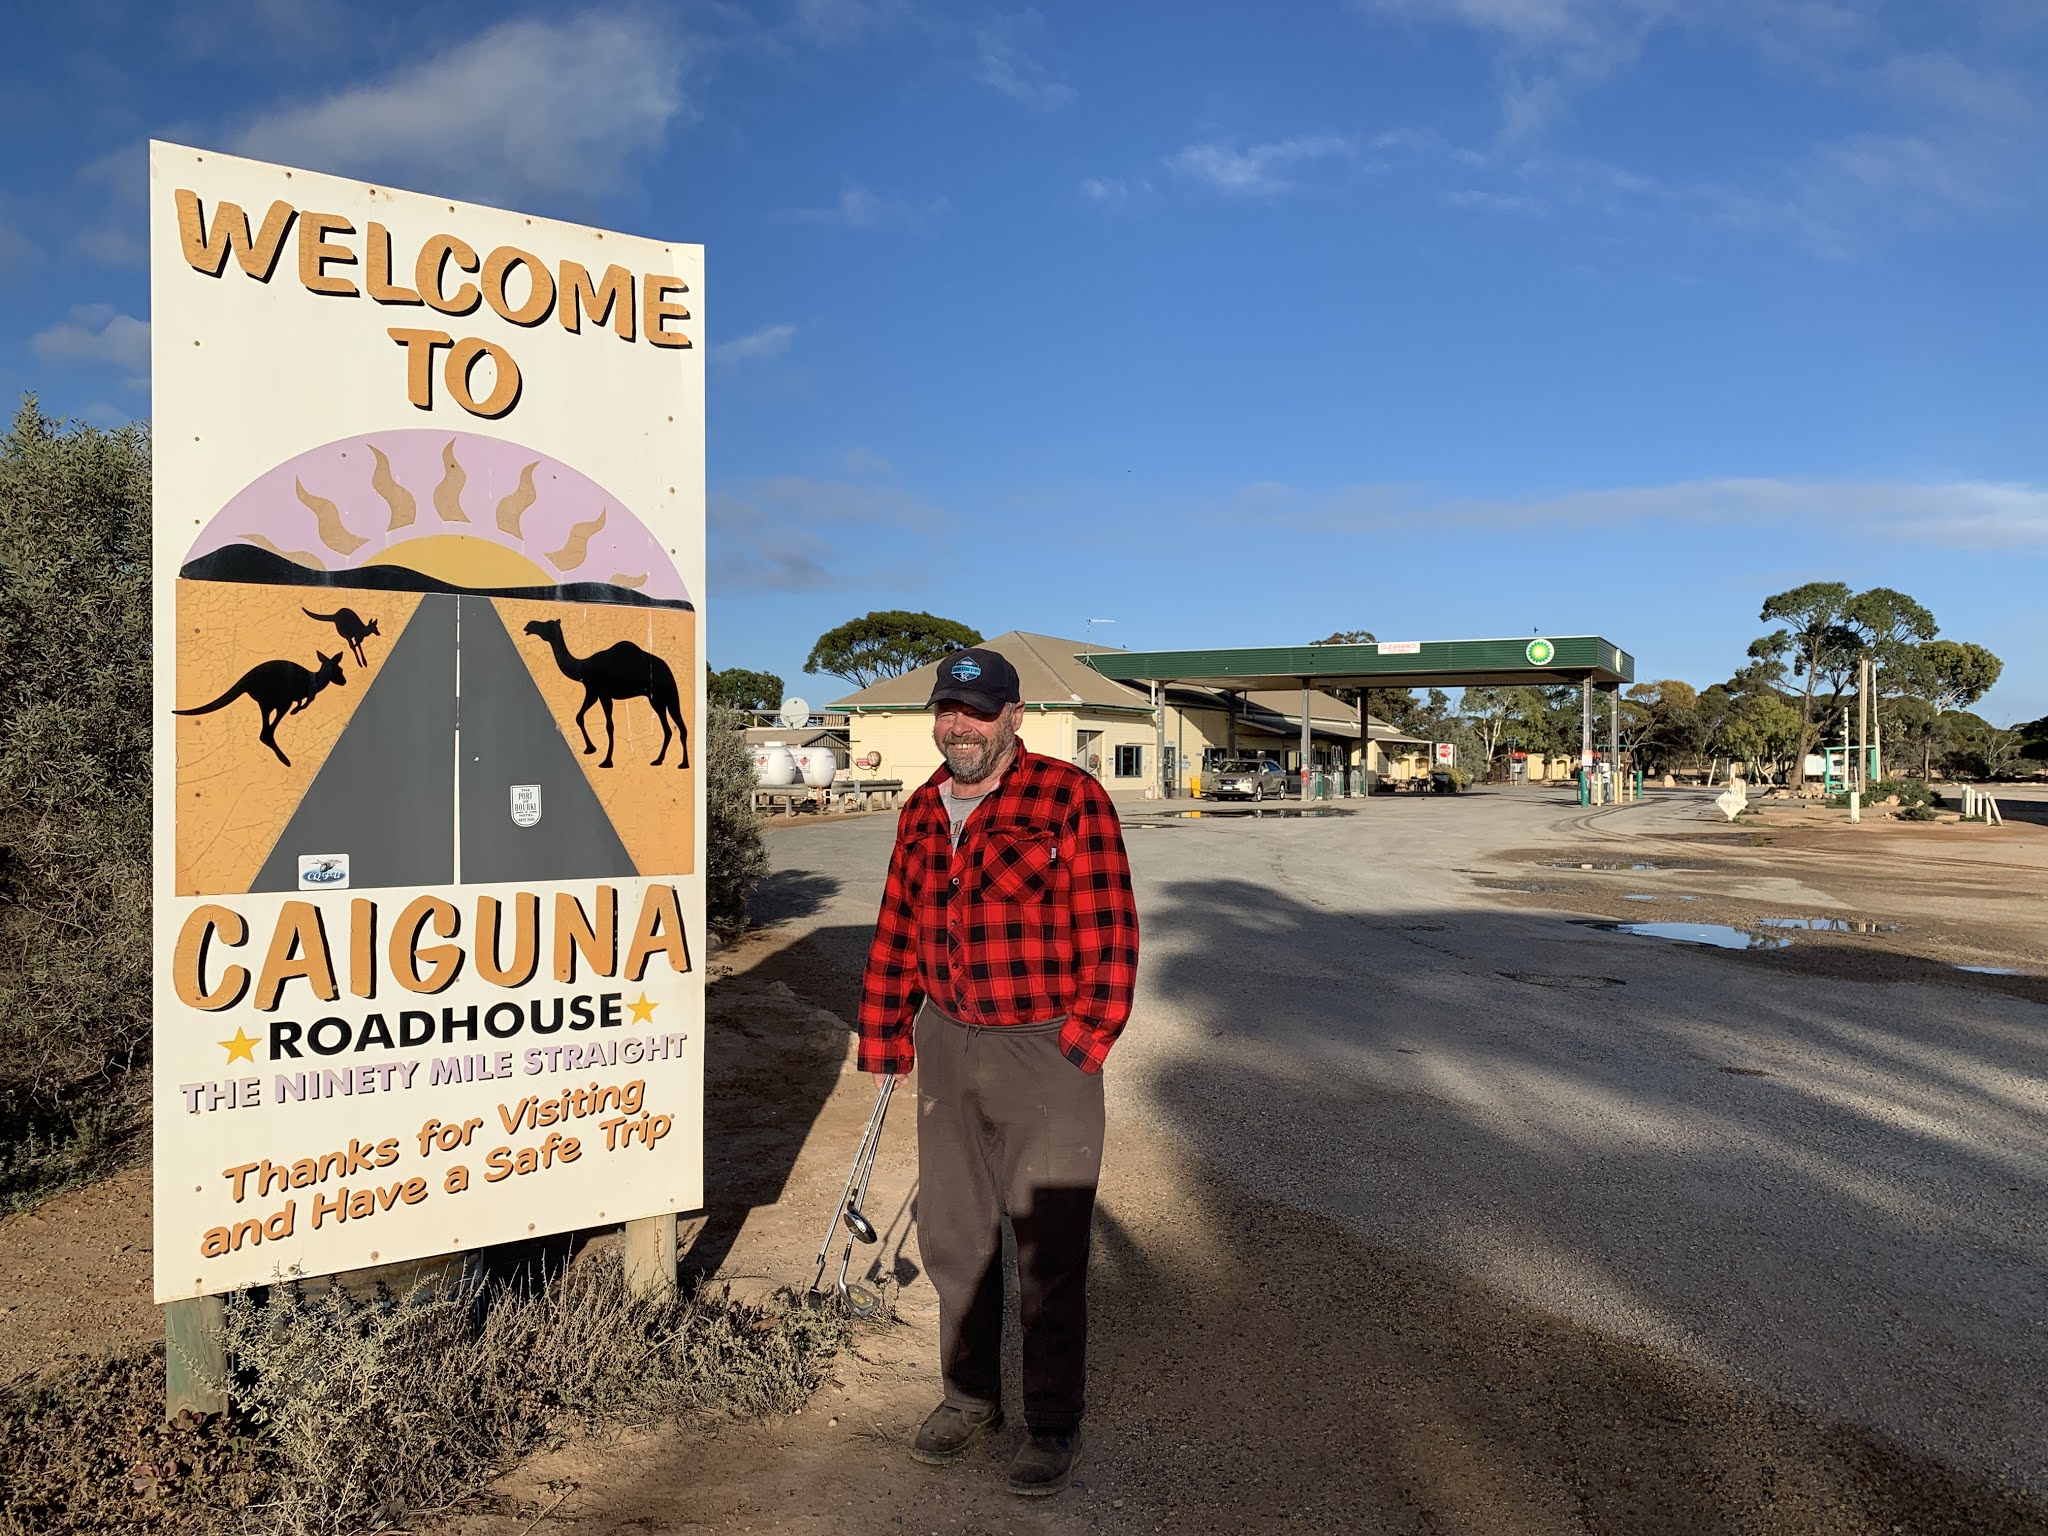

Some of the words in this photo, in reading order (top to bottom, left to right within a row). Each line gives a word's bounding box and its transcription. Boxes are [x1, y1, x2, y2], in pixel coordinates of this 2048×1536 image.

[174, 188, 693, 349] WELCOME
[387, 327, 522, 420] TO
[514, 803, 537, 811] BOURKE
[172, 884, 693, 1012] CAIGUNA
[179, 1076, 260, 1114] THE
[274, 1060, 420, 1104] NINETY
[429, 1050, 512, 1086] MILE
[523, 1032, 687, 1075] STRAIGHT
[269, 992, 622, 1061] ROADHOUSE
[200, 1199, 296, 1258] and
[311, 1176, 429, 1230] Have
[443, 1165, 469, 1194] a
[483, 1131, 583, 1183] Safe
[598, 1110, 673, 1152] Trip
[222, 1138, 400, 1203] Thanks
[416, 1118, 484, 1157] for
[497, 1079, 646, 1136] Visiting
